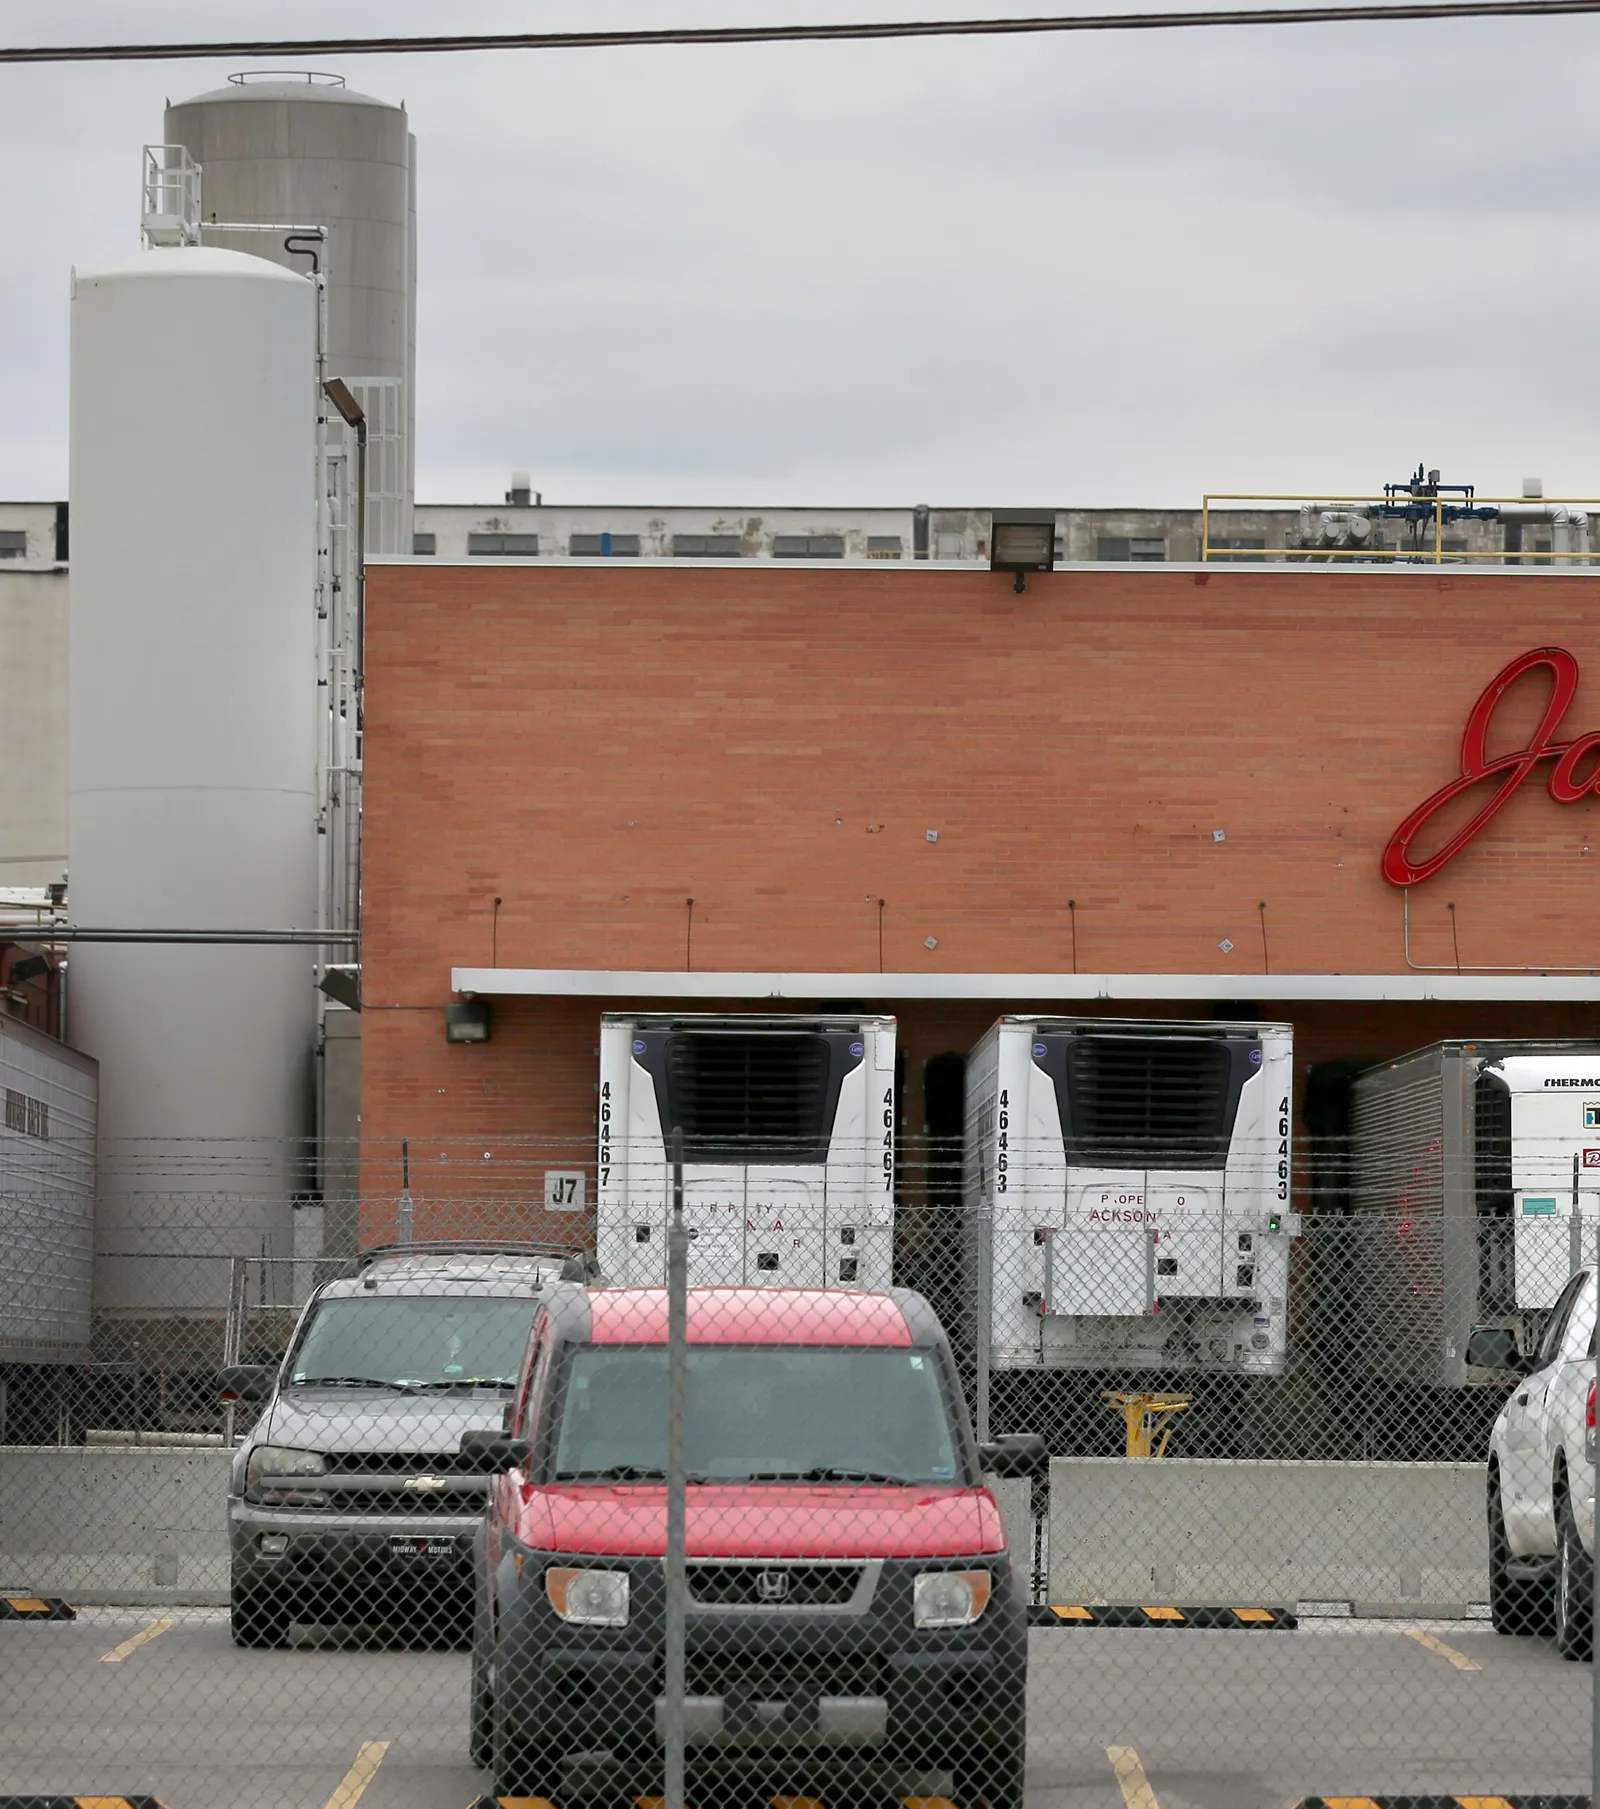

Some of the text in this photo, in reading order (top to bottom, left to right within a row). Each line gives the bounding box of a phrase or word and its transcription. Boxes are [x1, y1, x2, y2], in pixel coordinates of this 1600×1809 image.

[601, 1081, 611, 1187] 46467
[883, 1088, 893, 1192] 46467
[997, 1090, 1009, 1194] 46463
[1277, 1097, 1289, 1201] 46463
[552, 1177, 577, 1204] J7
[392, 1545, 453, 1554] MIDWAY MOTORS
